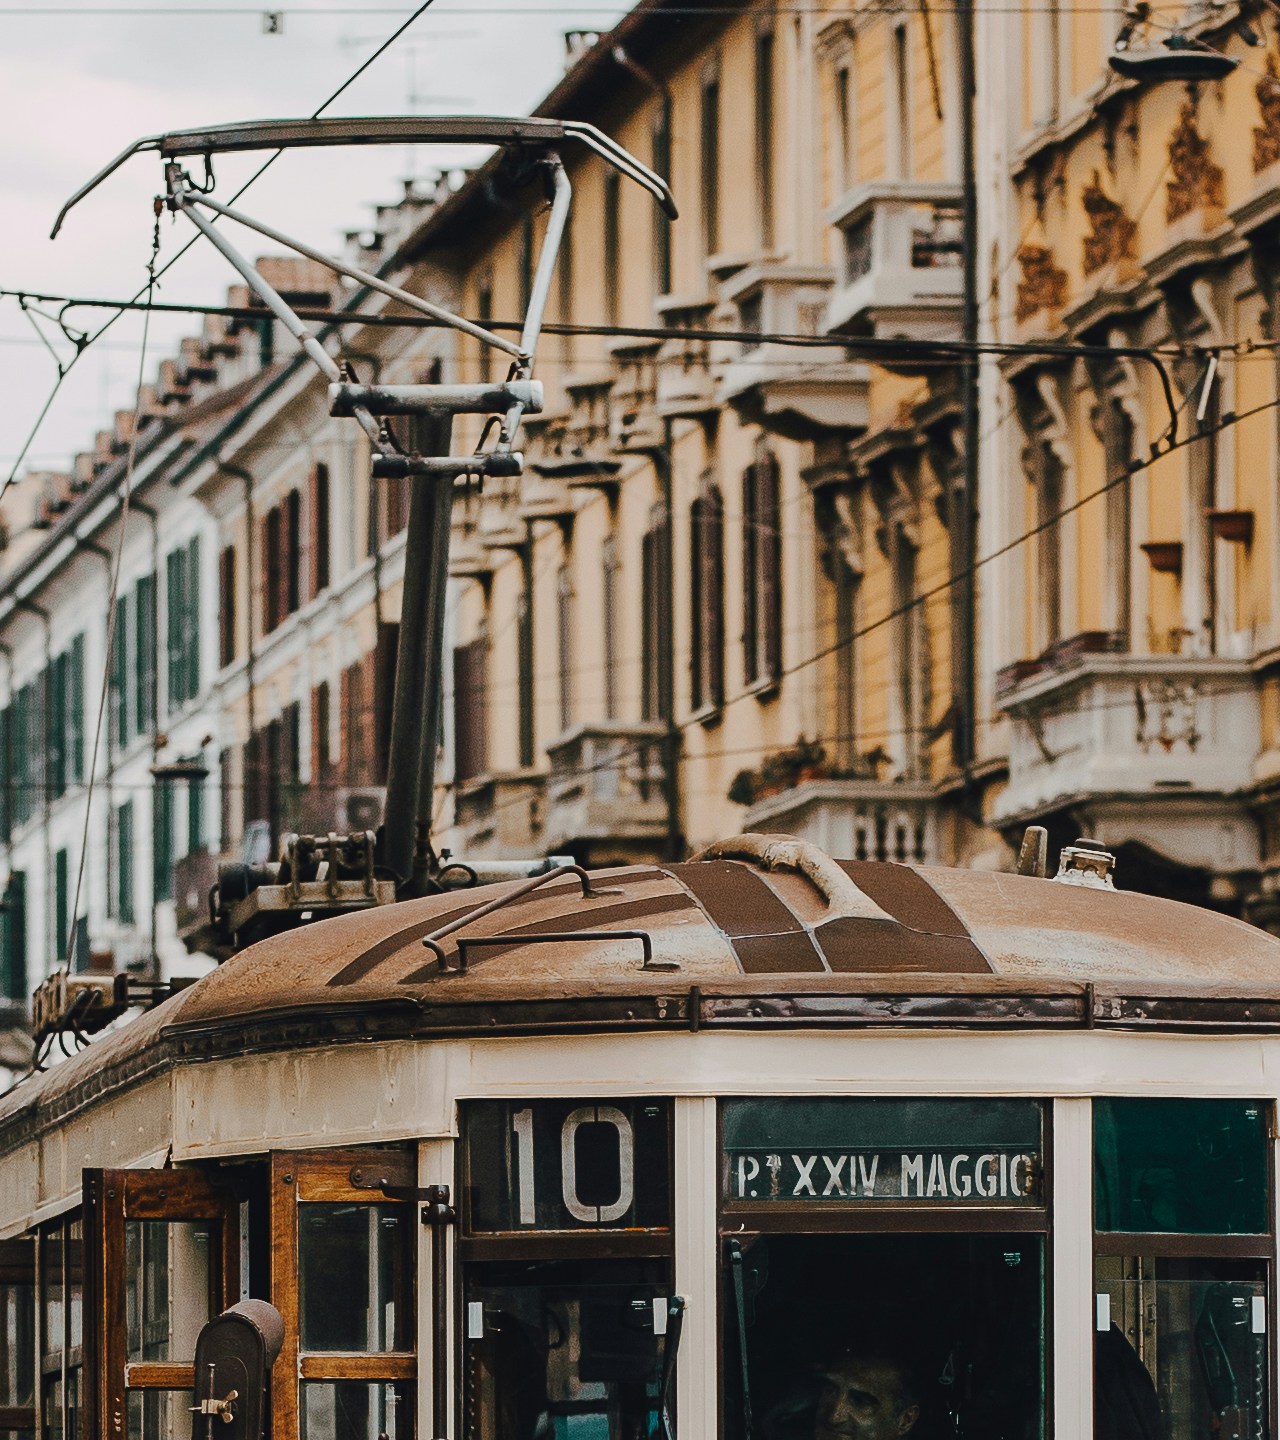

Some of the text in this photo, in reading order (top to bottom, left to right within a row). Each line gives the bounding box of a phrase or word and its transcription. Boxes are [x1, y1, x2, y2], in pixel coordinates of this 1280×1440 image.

[513, 1106, 634, 1222] 10
[791, 1155, 879, 1196] XXIV
[901, 1154, 1034, 1197] MAGGIO
